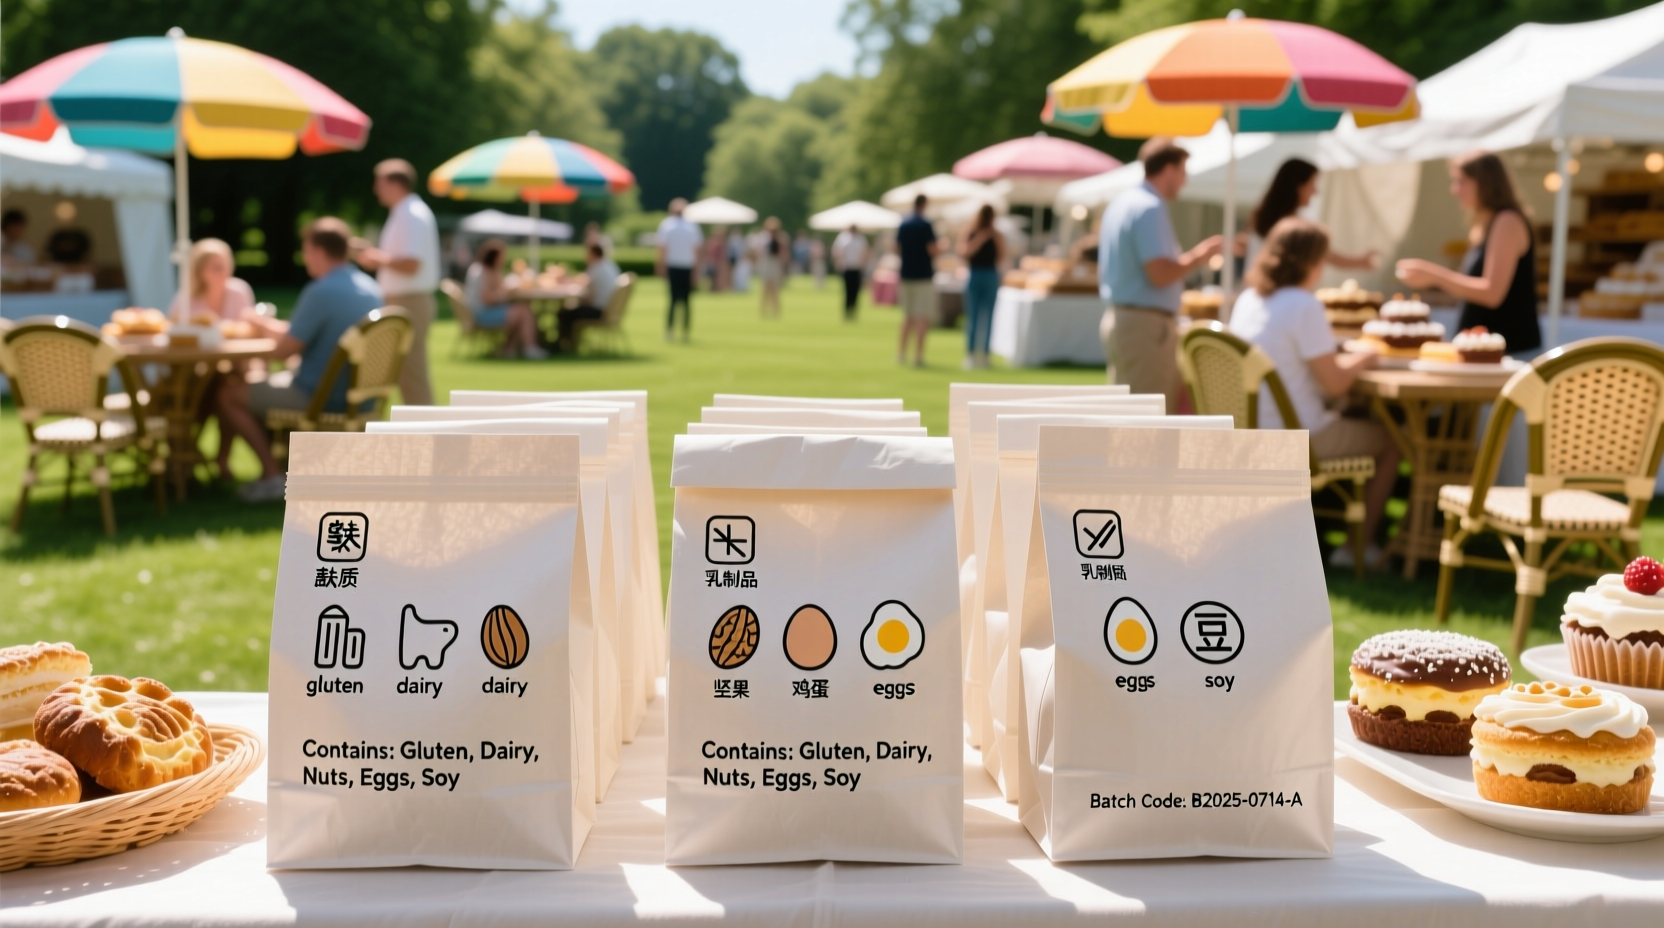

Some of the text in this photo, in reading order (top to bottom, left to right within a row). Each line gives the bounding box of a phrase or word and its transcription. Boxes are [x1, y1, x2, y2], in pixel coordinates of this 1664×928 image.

[705, 570, 757, 588] 乳制品
[1194, 612, 1233, 652] 豆
[307, 675, 363, 697] gluten
[397, 676, 442, 699] dairy
[482, 676, 528, 697] dairy
[714, 679, 749, 698] 坚果
[792, 679, 828, 698] 鸡蛋
[873, 683, 915, 699] eggs
[1115, 676, 1155, 692] eggs
[1205, 676, 1235, 692] soy
[303, 739, 538, 764] Contains: Gluten, Dairy,
[702, 741, 931, 763] Contains: Gluten, Dairy,
[304, 766, 460, 791] Nuts, Eggs, Soy
[704, 768, 861, 792] Nuts, Eggs, Soy
[1091, 792, 1302, 808] Batch Code: B2025-0714-A
